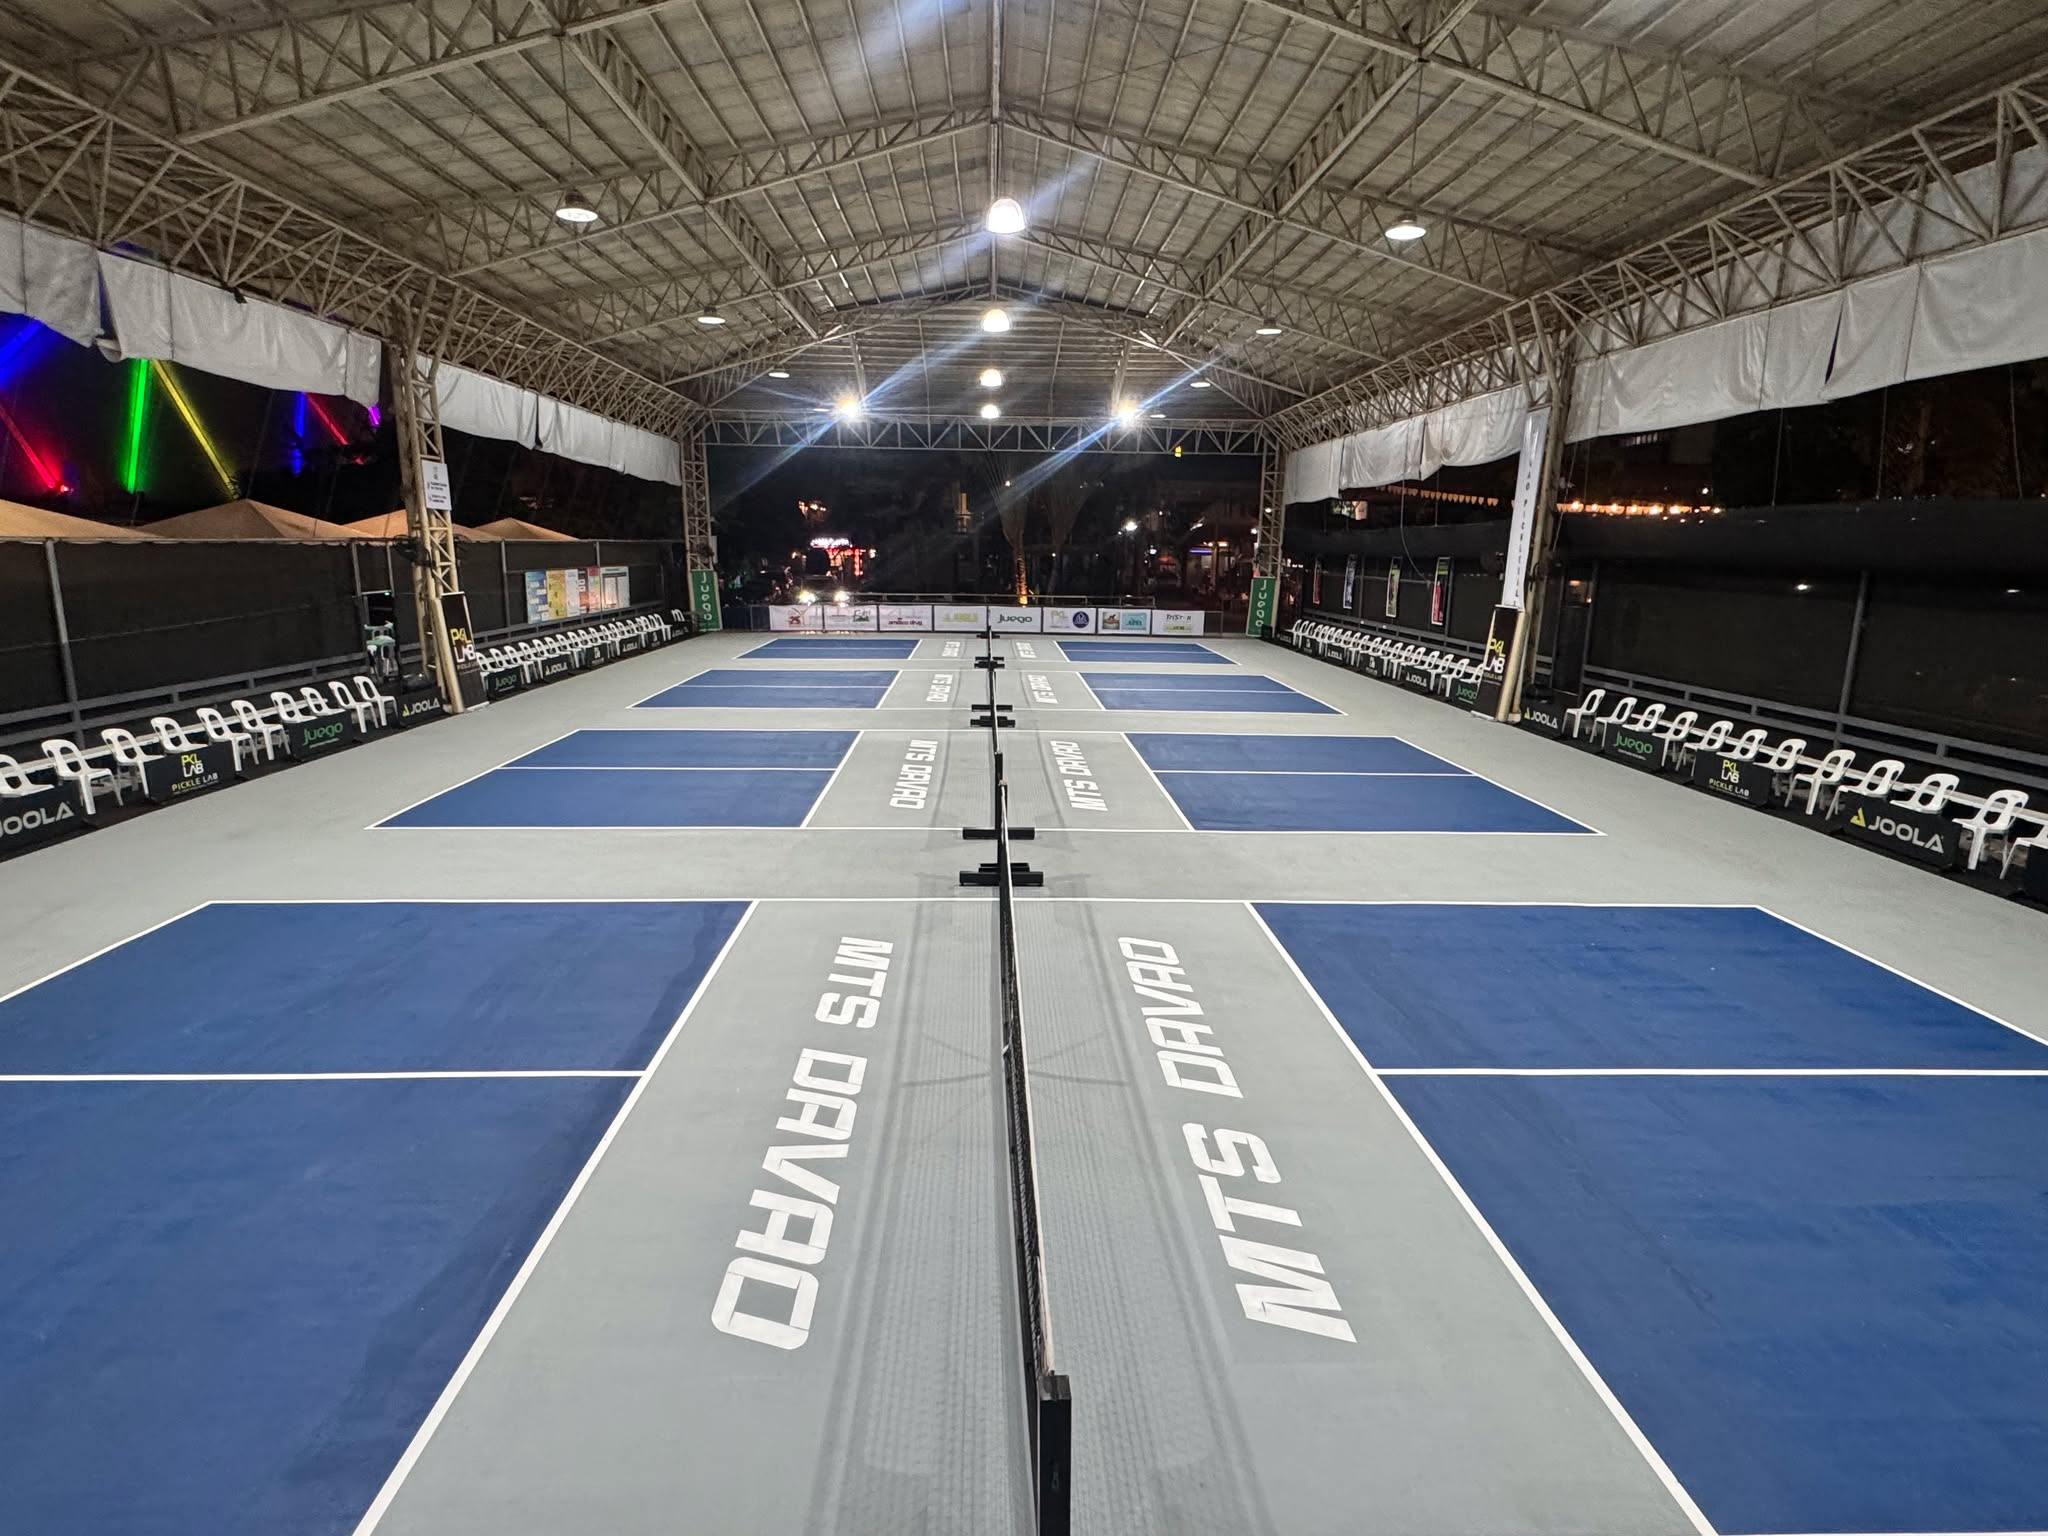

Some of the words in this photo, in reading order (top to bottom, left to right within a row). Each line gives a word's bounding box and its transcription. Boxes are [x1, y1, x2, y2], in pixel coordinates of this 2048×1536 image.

[411, 698, 441, 715] JOOLA
[1531, 711, 1559, 729] JOOLA
[904, 739, 939, 762] MTS
[1050, 740, 1093, 777] DAVAO
[171, 777, 201, 792] PICKLE
[202, 772, 219, 783] LAB
[183, 762, 205, 778] LAB
[889, 763, 933, 810] DAVAO
[1721, 769, 1740, 784] LAB
[1063, 778, 1109, 812] MTS
[1709, 778, 1734, 792] PICKLE
[1734, 786, 1750, 797] LAB
[1868, 815, 1945, 854] JOOLA
[814, 936, 894, 1029] MTS
[1117, 936, 1244, 1099] DAVAO
[710, 1047, 869, 1351] DAVAO
[1182, 1122, 1358, 1344] MTS
